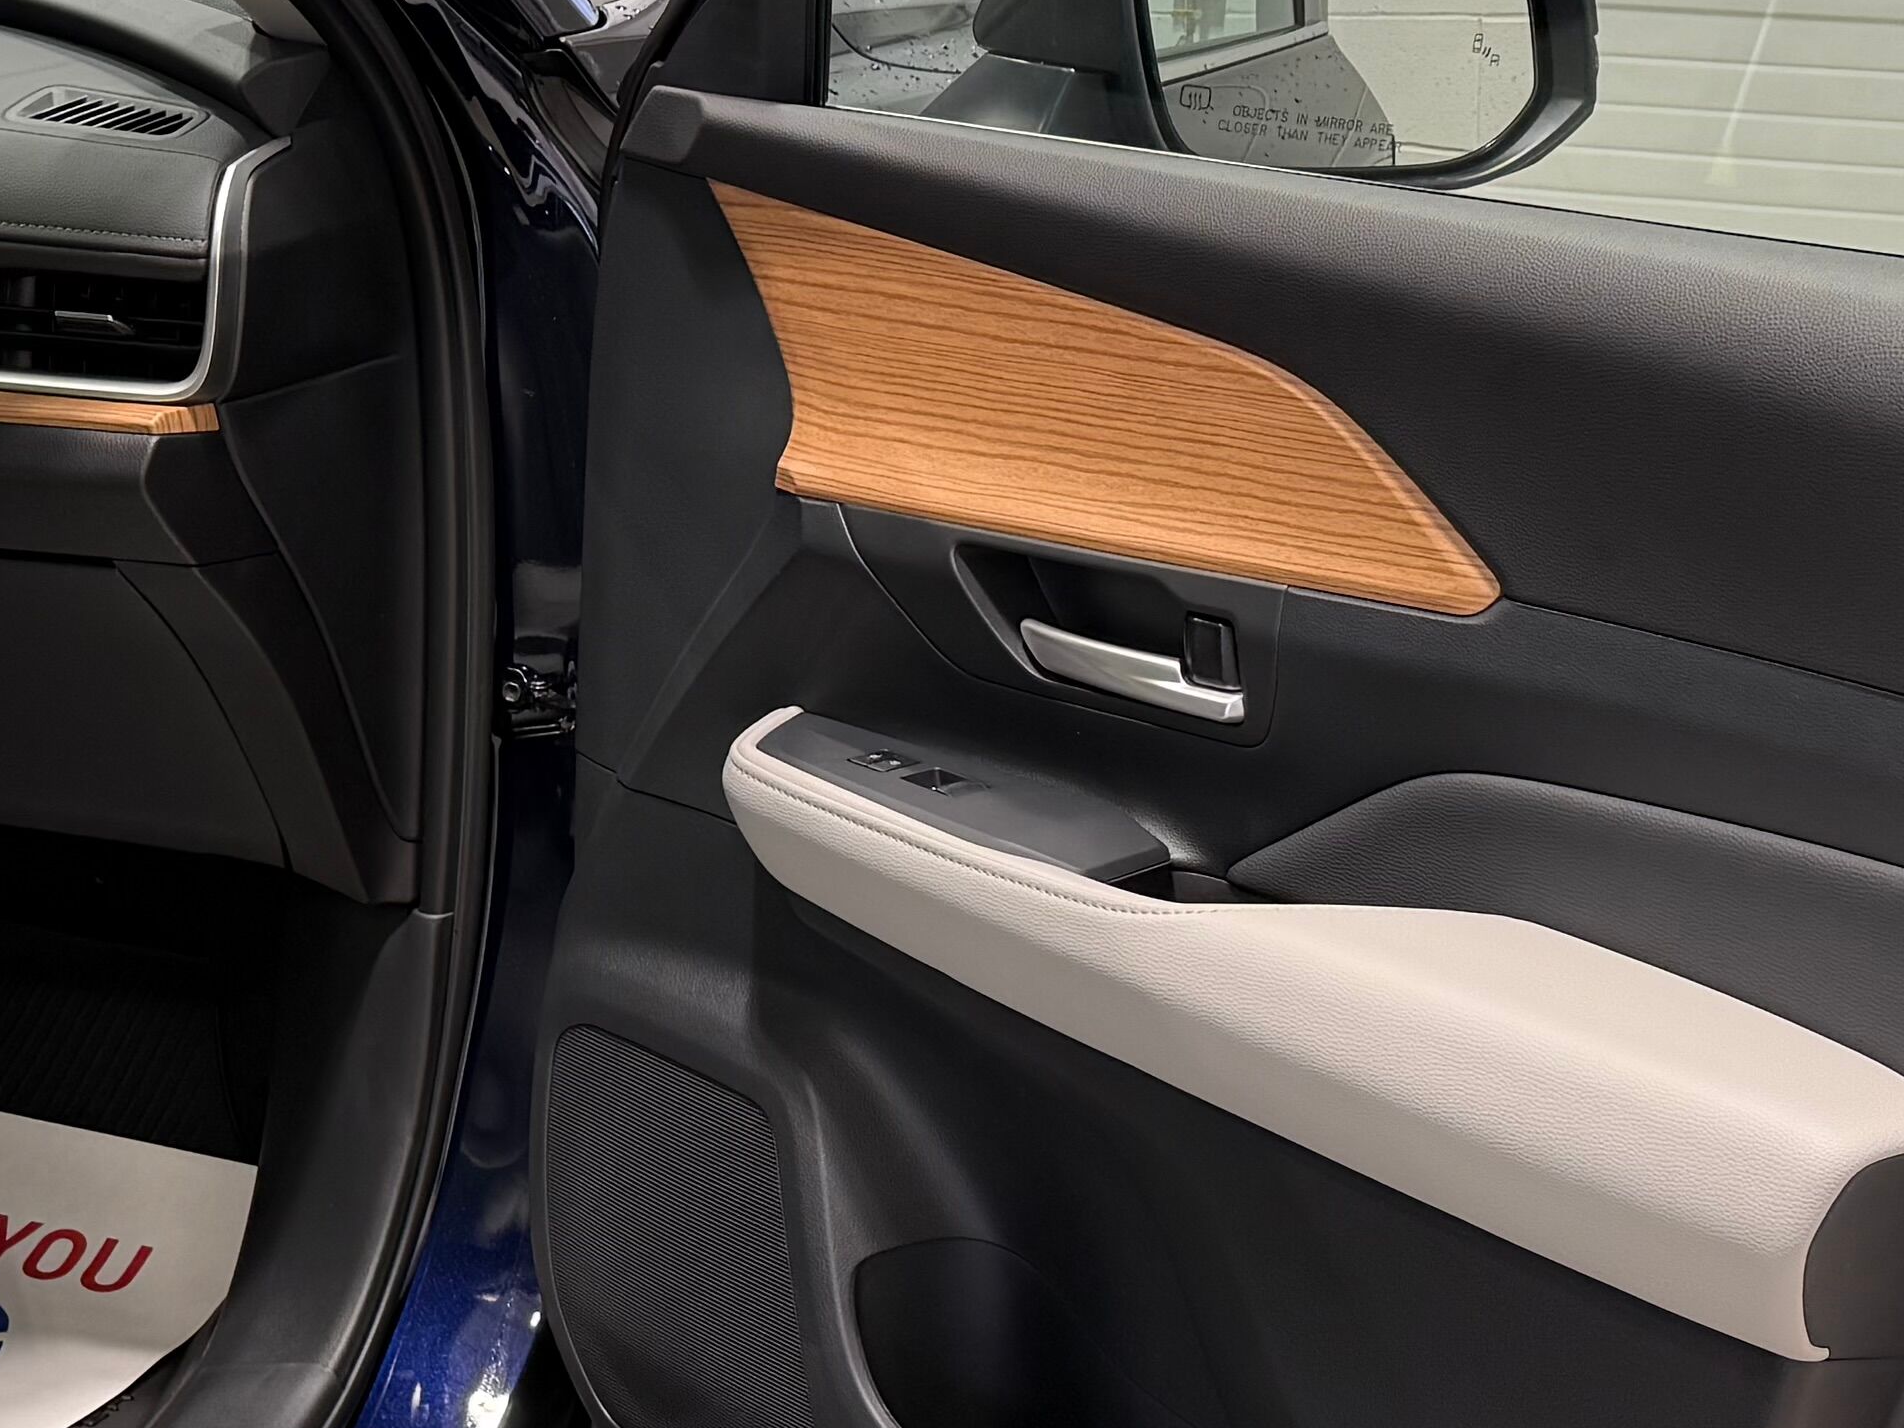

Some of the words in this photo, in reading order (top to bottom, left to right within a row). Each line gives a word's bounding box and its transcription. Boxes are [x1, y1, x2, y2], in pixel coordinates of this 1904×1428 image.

[1218, 119, 1268, 137] CLOSER
[1277, 126, 1309, 141] THAN
[1318, 132, 1347, 146] THEY
[1354, 137, 1403, 153] APPEAR
[1232, 105, 1289, 123] OBJECTS
[1297, 113, 1309, 125] IN
[1315, 116, 1363, 132] MIRROR
[1370, 123, 1395, 135] ARE
